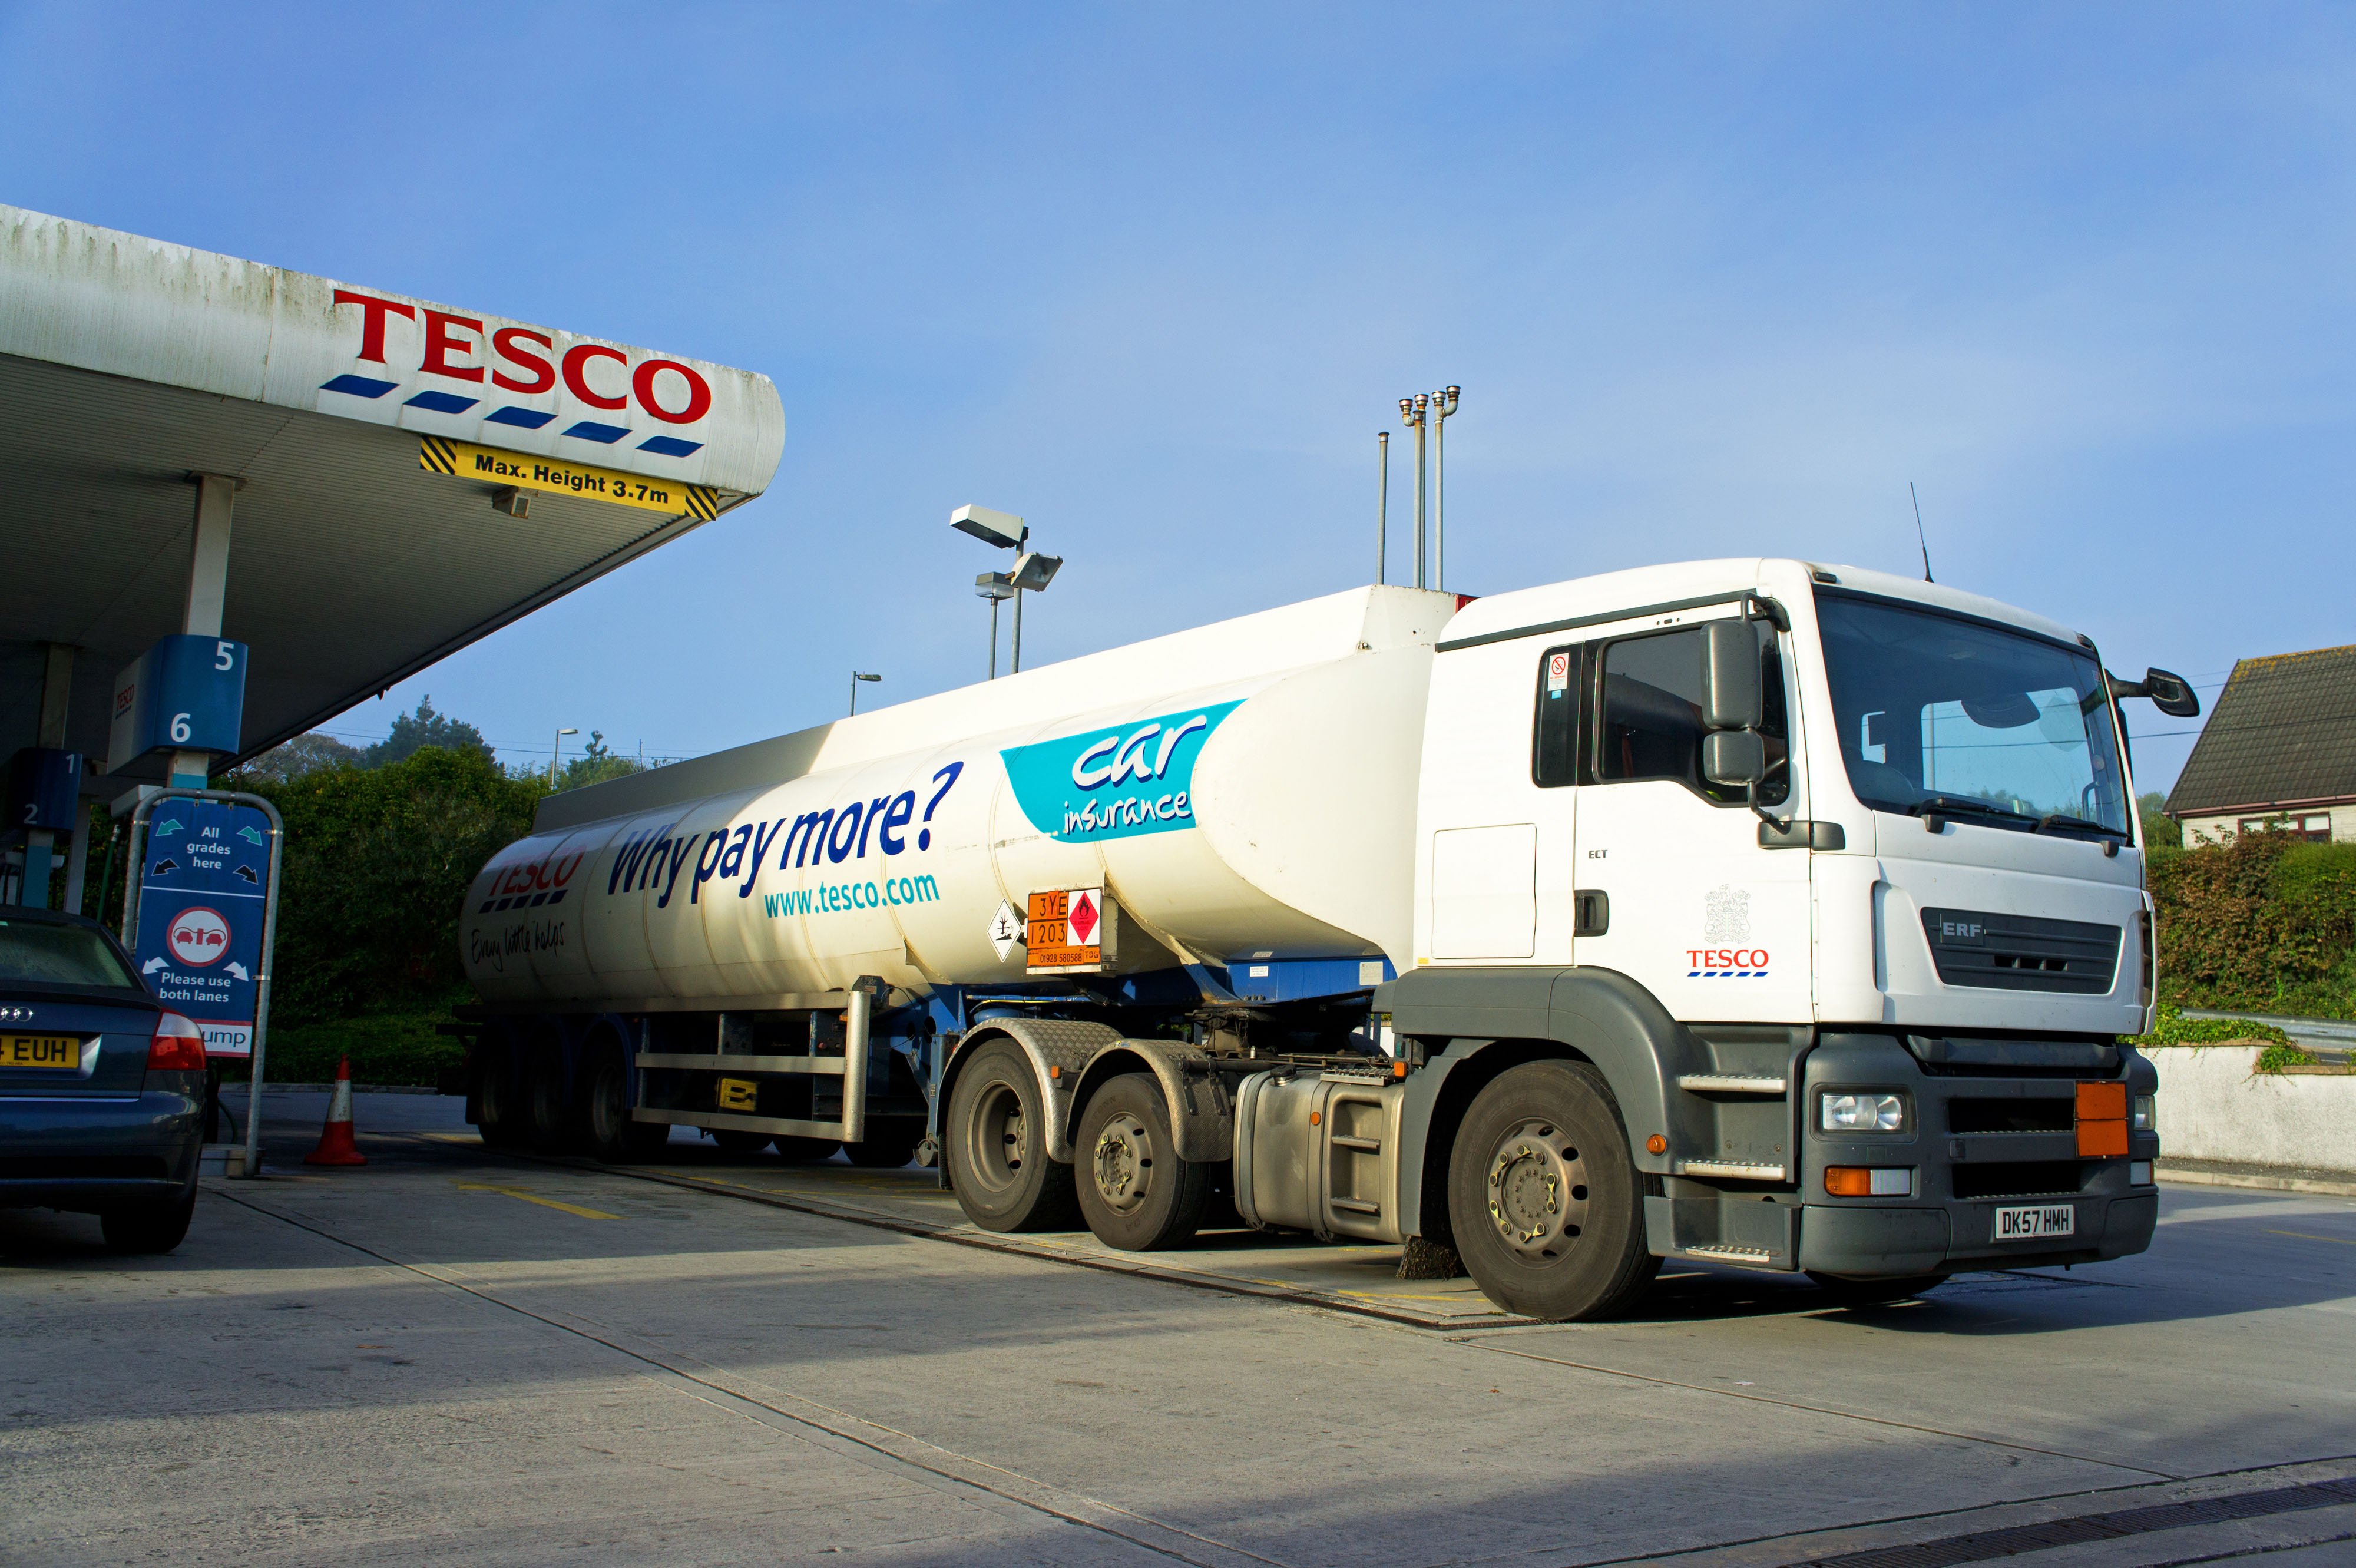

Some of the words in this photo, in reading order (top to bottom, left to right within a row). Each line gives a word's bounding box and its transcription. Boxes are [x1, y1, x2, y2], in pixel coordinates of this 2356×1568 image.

[333, 289, 712, 424] TESCO
[475, 454, 527, 479] Max.
[534, 465, 605, 492] Height
[613, 479, 669, 505] 3.7m
[214, 641, 234, 671] 5
[117, 684, 134, 712] TESCO
[170, 713, 192, 742] 6
[65, 753, 76, 774] 1
[1072, 715, 1207, 792] car
[23, 804, 38, 825] 2
[1063, 791, 1192, 835] insurance
[201, 827, 220, 838] All
[607, 822, 701, 909] Why
[691, 817, 787, 905] pay
[779, 760, 964, 870] more?
[187, 841, 231, 855] grades
[1588, 849, 1608, 859] ECT
[193, 856, 222, 869] here
[489, 843, 587, 897] TESCO
[764, 874, 941, 919] www.tesco.com
[1040, 895, 1067, 917] 3YE
[1031, 922, 1066, 944] 1203
[1943, 922, 1981, 938] ERF
[471, 929, 504, 972] Every
[505, 923, 531, 957] little
[535, 919, 565, 958] helps
[1040, 954, 1057, 963] 01928
[1059, 952, 1083, 962] 580588
[1686, 949, 1769, 968] TESCO
[161, 972, 205, 986] Please
[208, 976, 231, 988] use
[159, 988, 190, 1001] both
[194, 990, 229, 1003] lanes
[14, 1038, 67, 1062] EUH
[202, 1031, 246, 1048] ump
[2002, 1210, 2040, 1234] DK57
[2044, 1209, 2069, 1232] HMH
